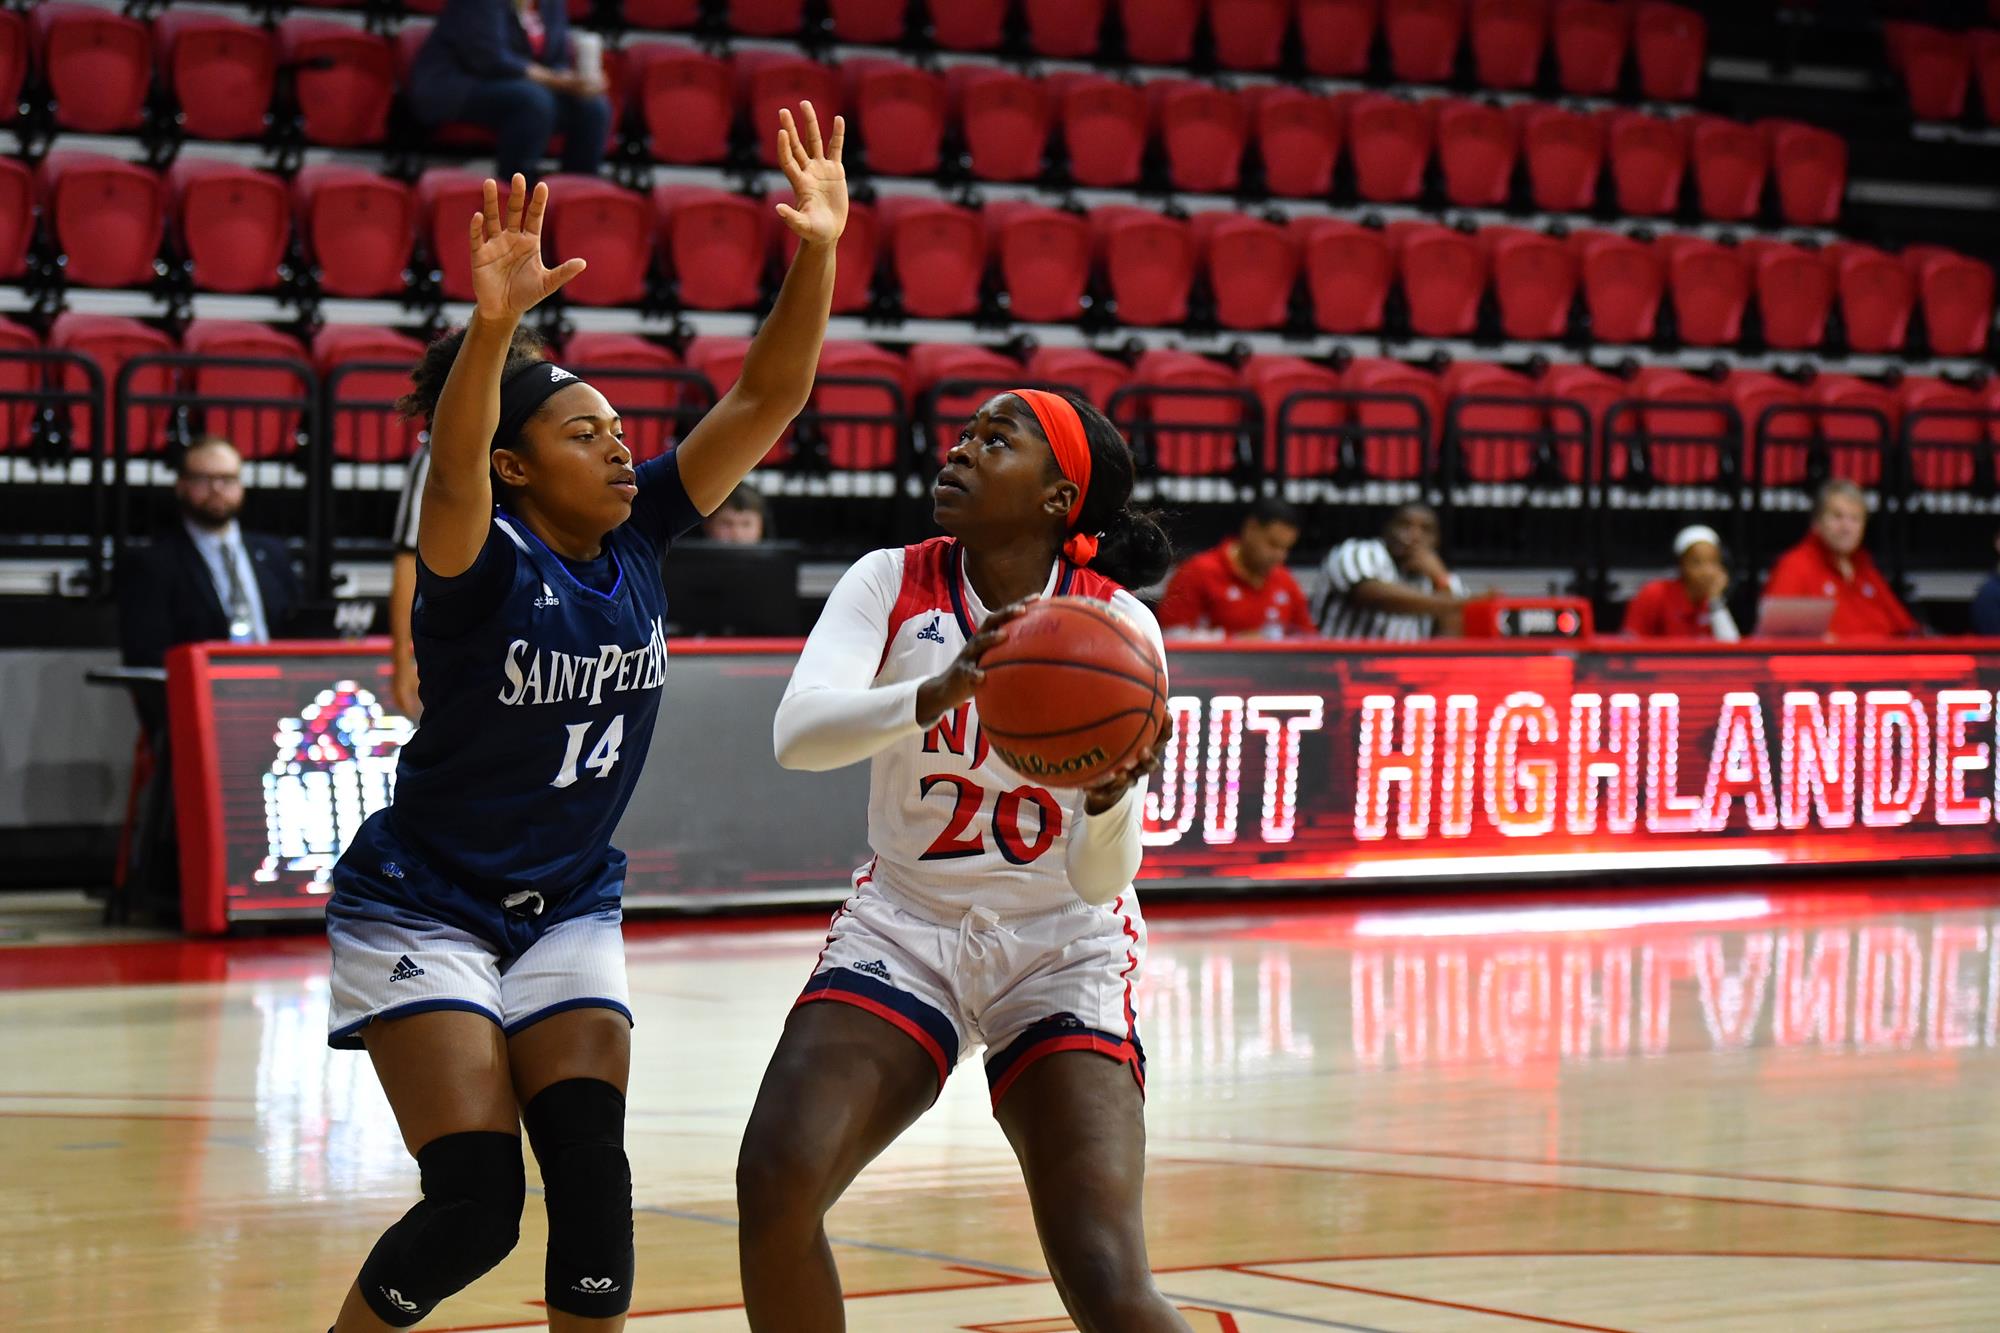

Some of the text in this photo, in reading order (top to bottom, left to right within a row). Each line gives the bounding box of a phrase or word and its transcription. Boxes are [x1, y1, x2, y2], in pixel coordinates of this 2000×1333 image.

[550, 715, 625, 788] 14
[1353, 689, 2000, 841] HIGHLANDE
[918, 773, 1063, 865] 20
[389, 968, 425, 983] adidas
[853, 960, 891, 981] adidas
